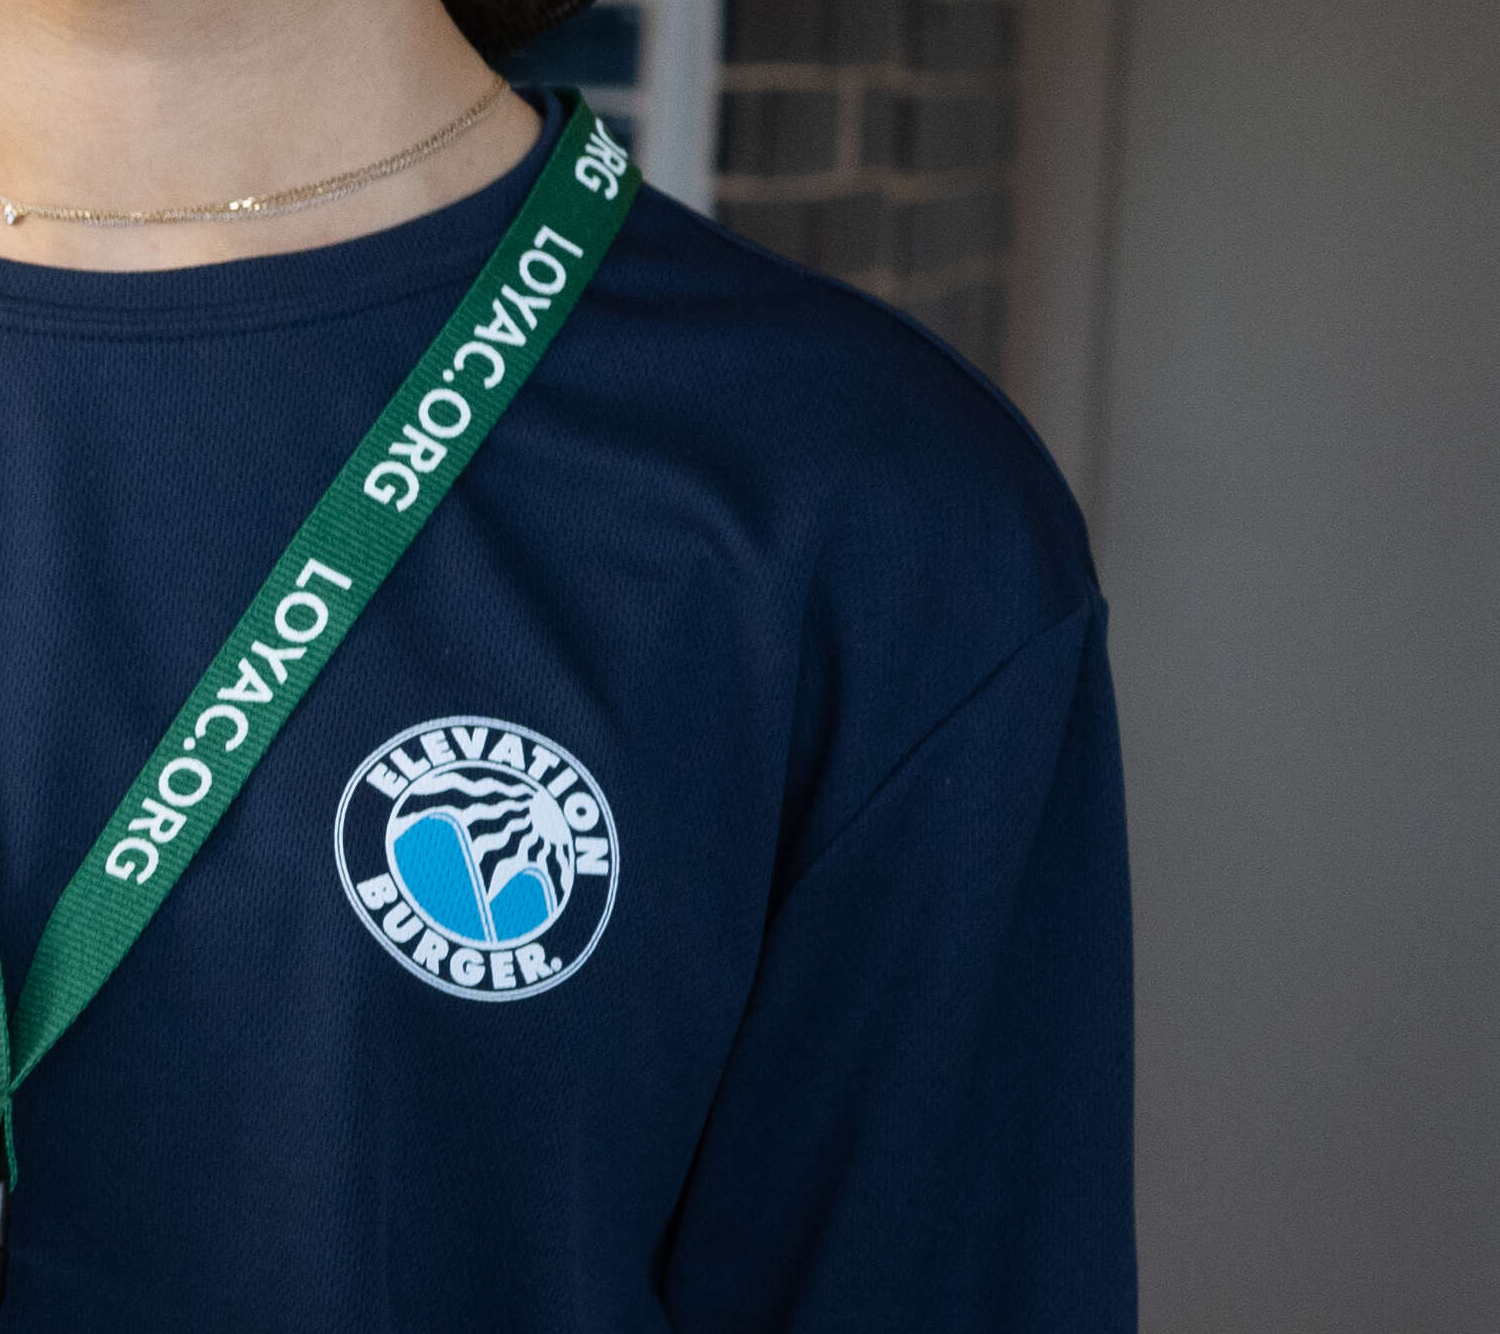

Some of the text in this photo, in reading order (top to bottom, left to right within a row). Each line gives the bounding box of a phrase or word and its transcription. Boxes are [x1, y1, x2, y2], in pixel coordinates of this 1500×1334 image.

[362, 224, 584, 513] LOYAC.ORG
[104, 557, 353, 887] LOYAC.ORG
[366, 726, 610, 876] ELEVATION
